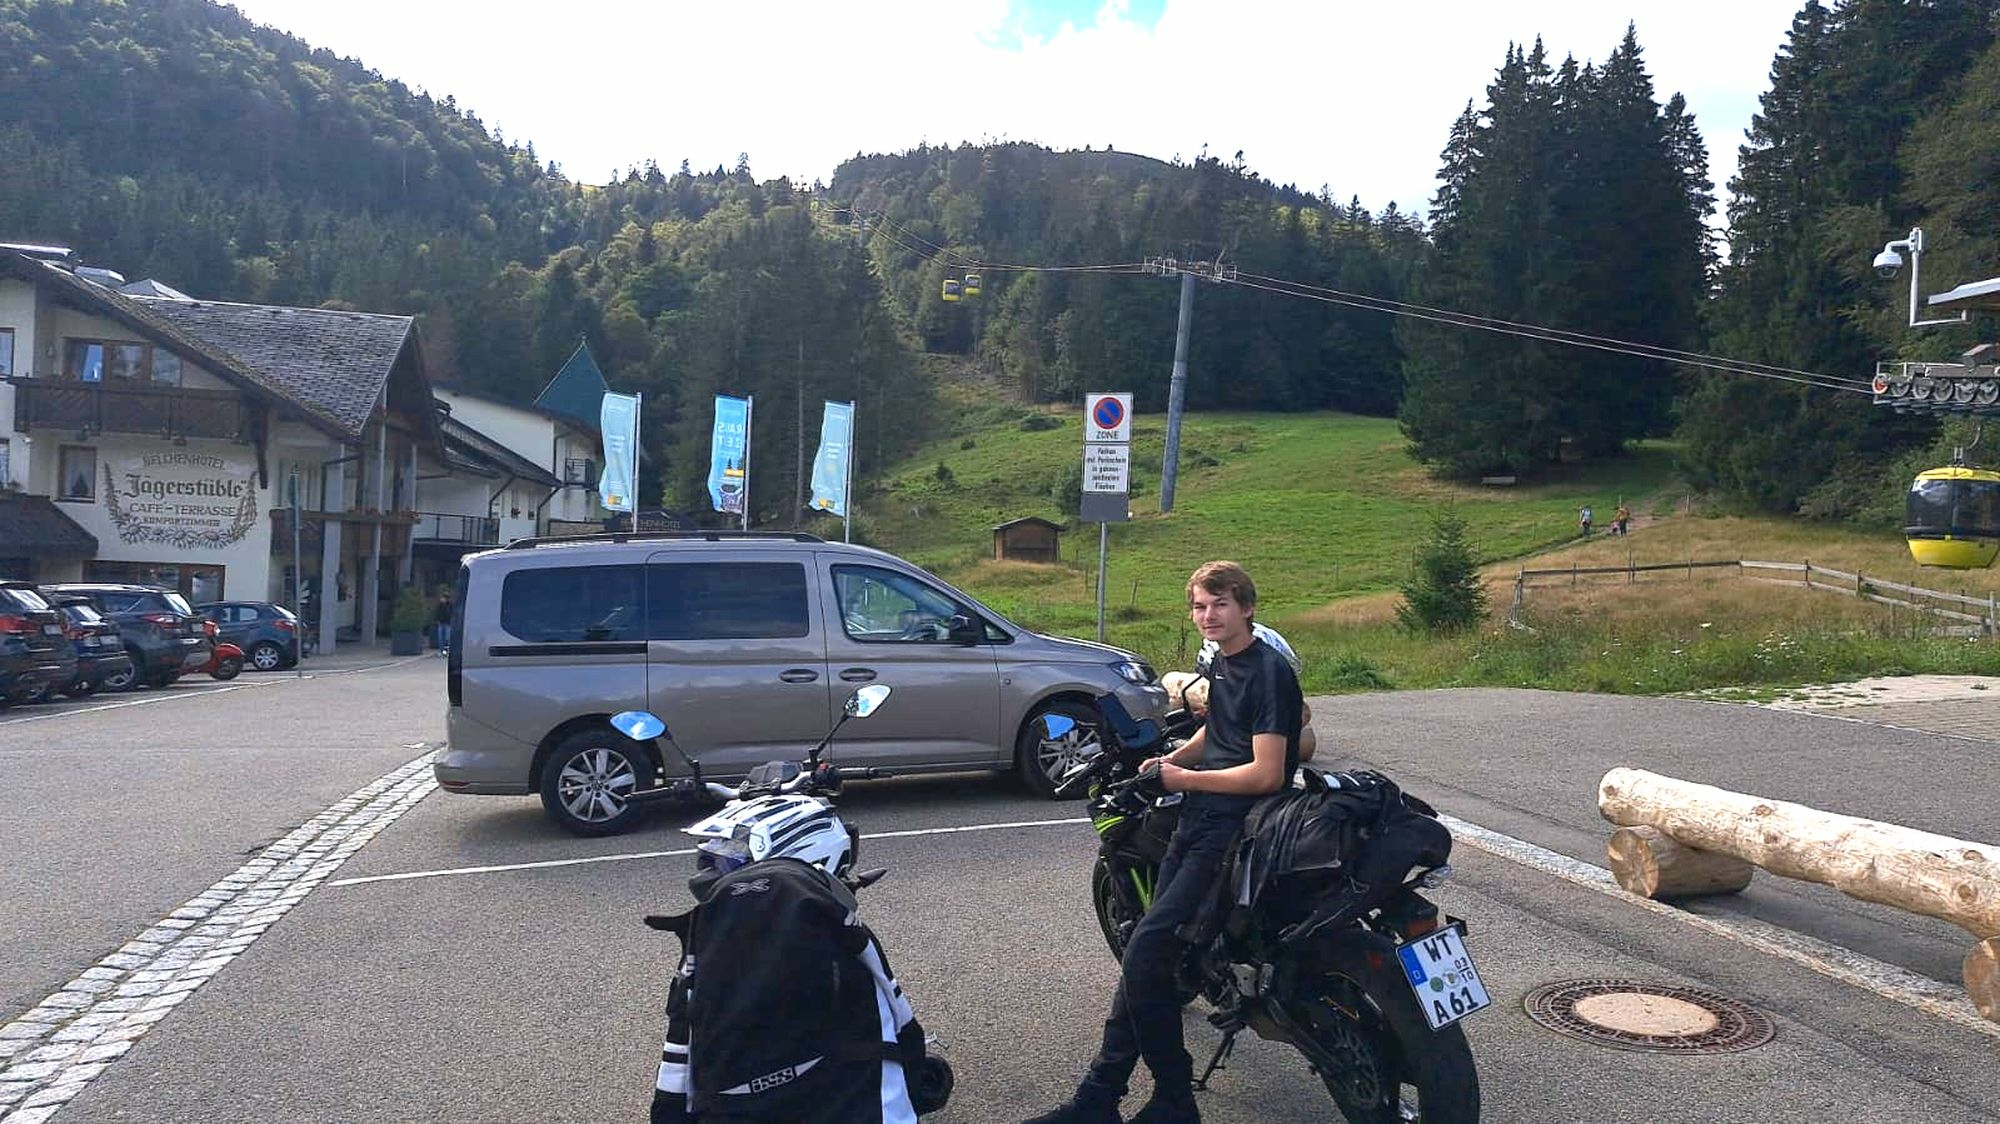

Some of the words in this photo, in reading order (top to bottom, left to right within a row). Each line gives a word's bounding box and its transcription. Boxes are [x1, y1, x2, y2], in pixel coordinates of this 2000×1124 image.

[1096, 430, 1120, 439] ZONE
[1423, 932, 1452, 963] WT
[1453, 956, 1469, 969] 03
[1461, 970, 1475, 984] 10
[1433, 999, 1451, 1024] A
[1449, 986, 1479, 1016] 61
